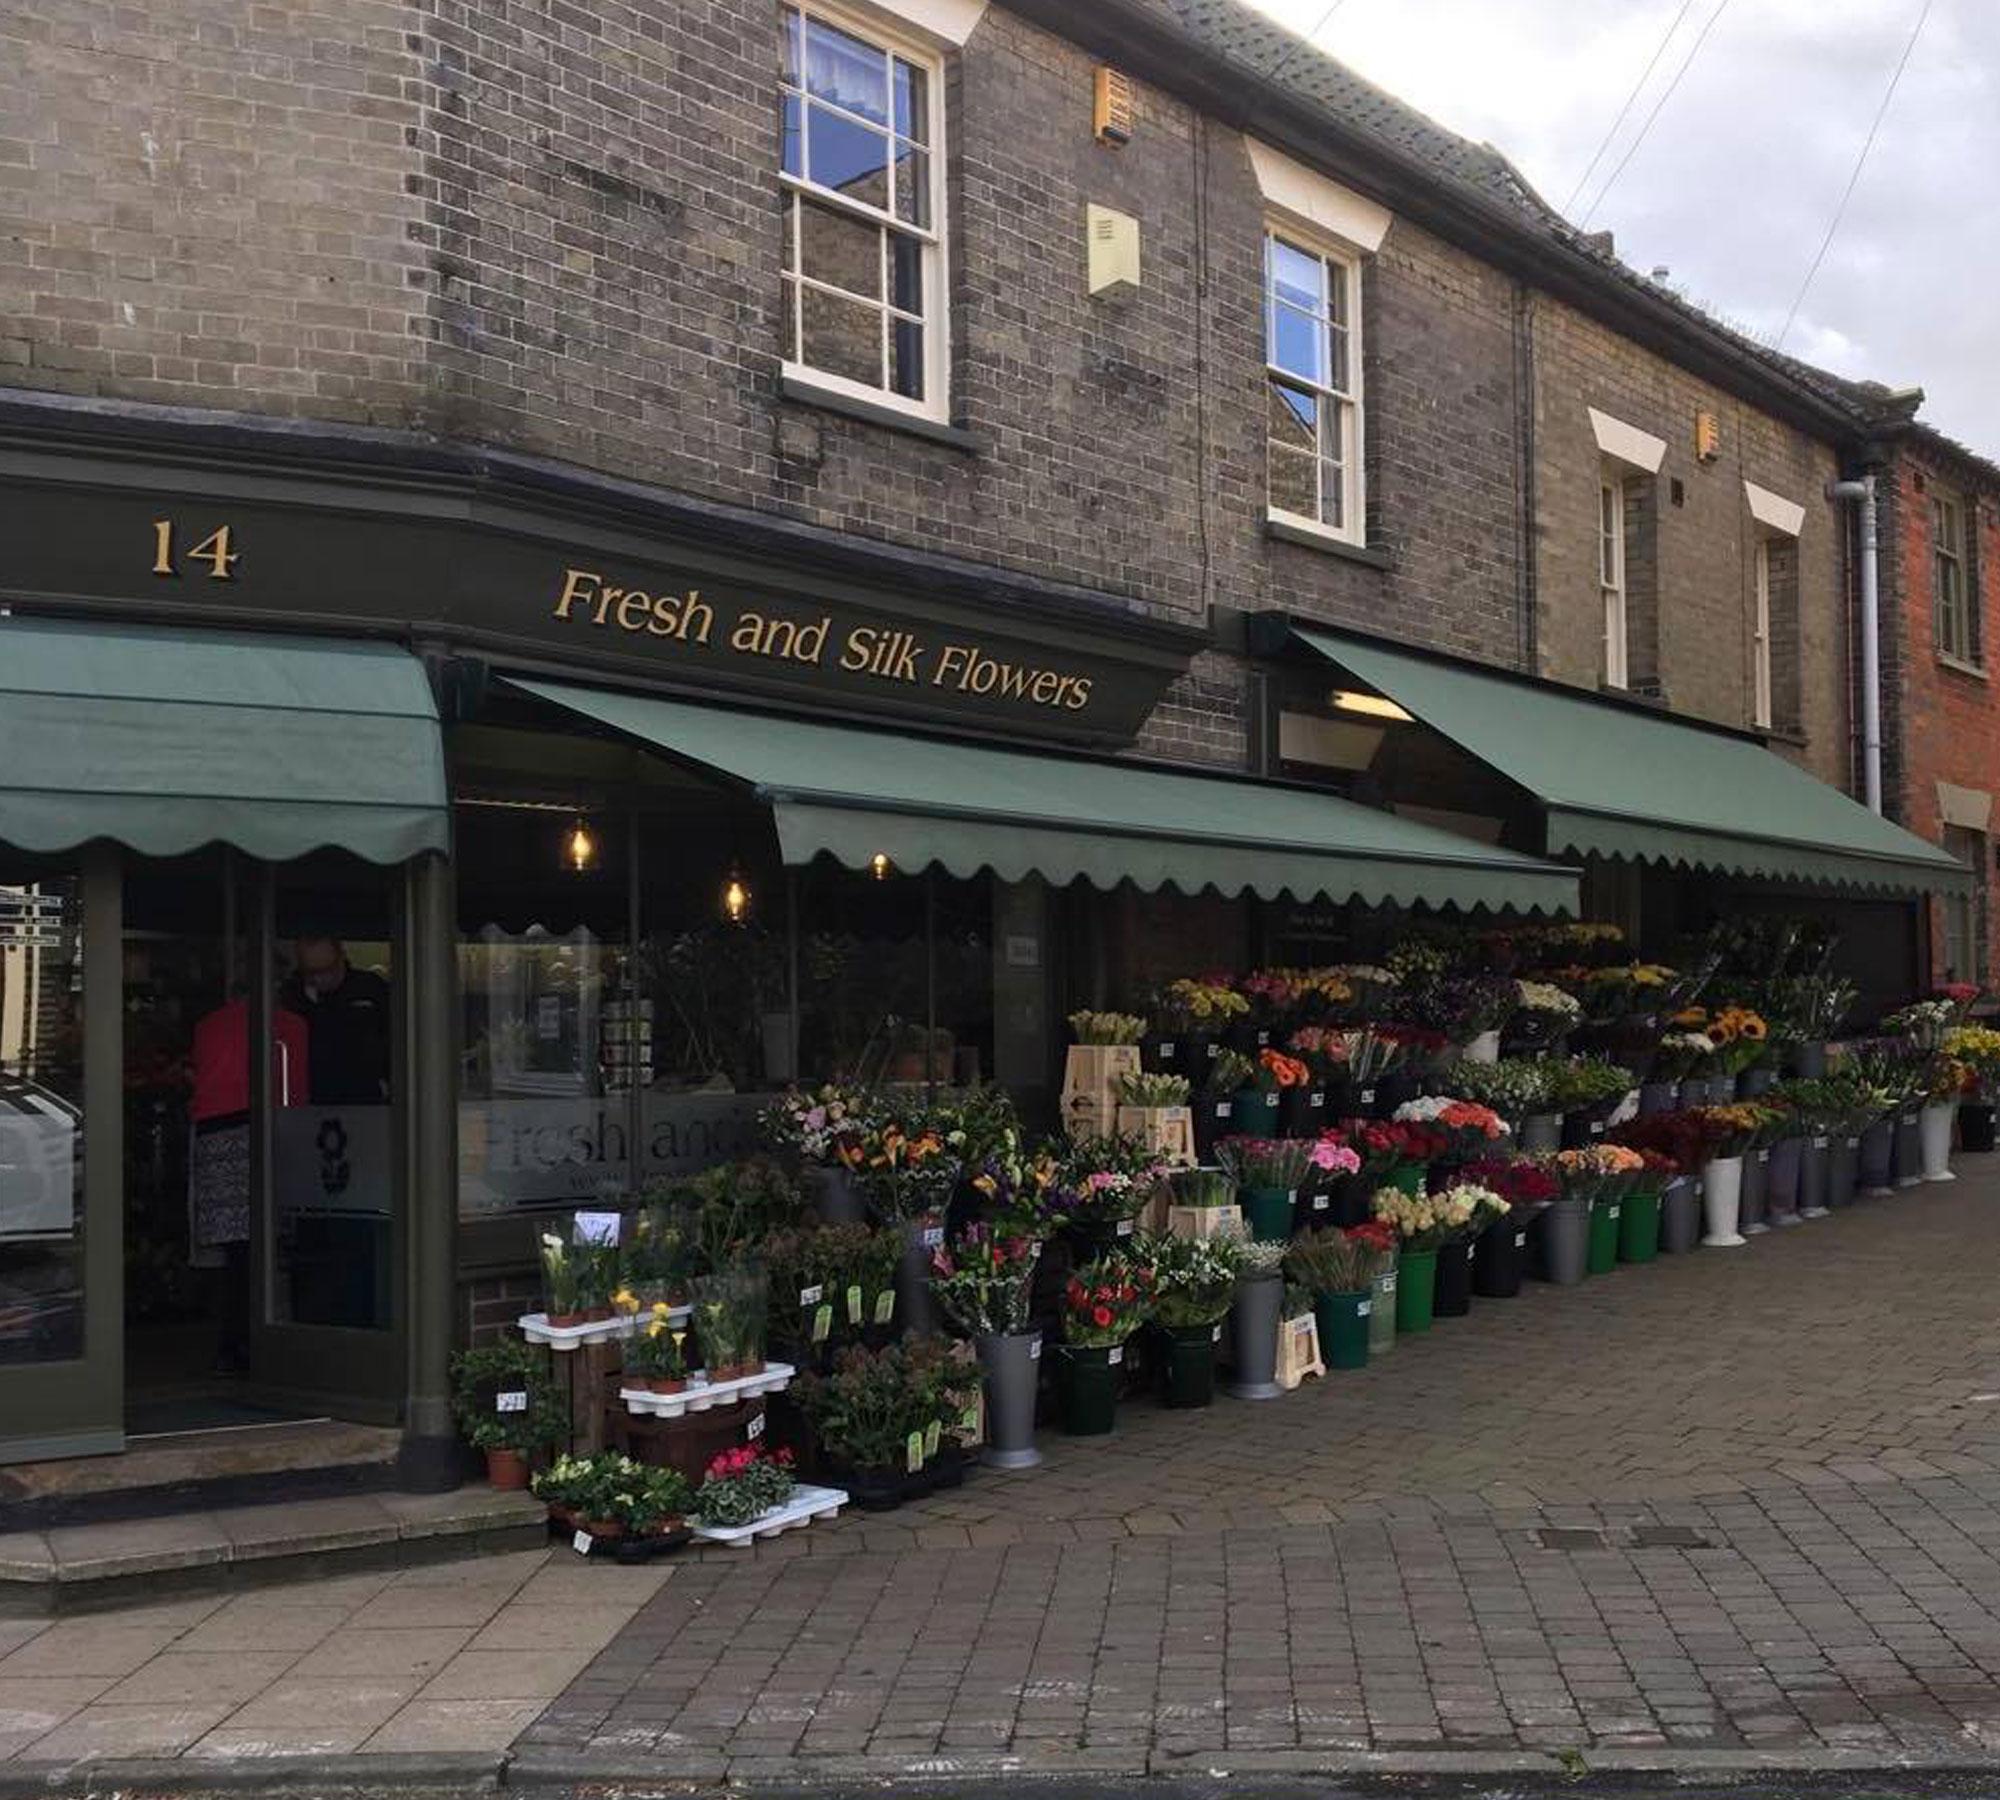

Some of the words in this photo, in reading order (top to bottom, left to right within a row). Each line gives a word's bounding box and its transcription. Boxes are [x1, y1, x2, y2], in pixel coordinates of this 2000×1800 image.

[152, 520, 239, 577] 14
[553, 568, 713, 643] Fresh
[731, 613, 832, 664] and
[840, 626, 924, 683] Silk
[932, 645, 1094, 711] Flowers
